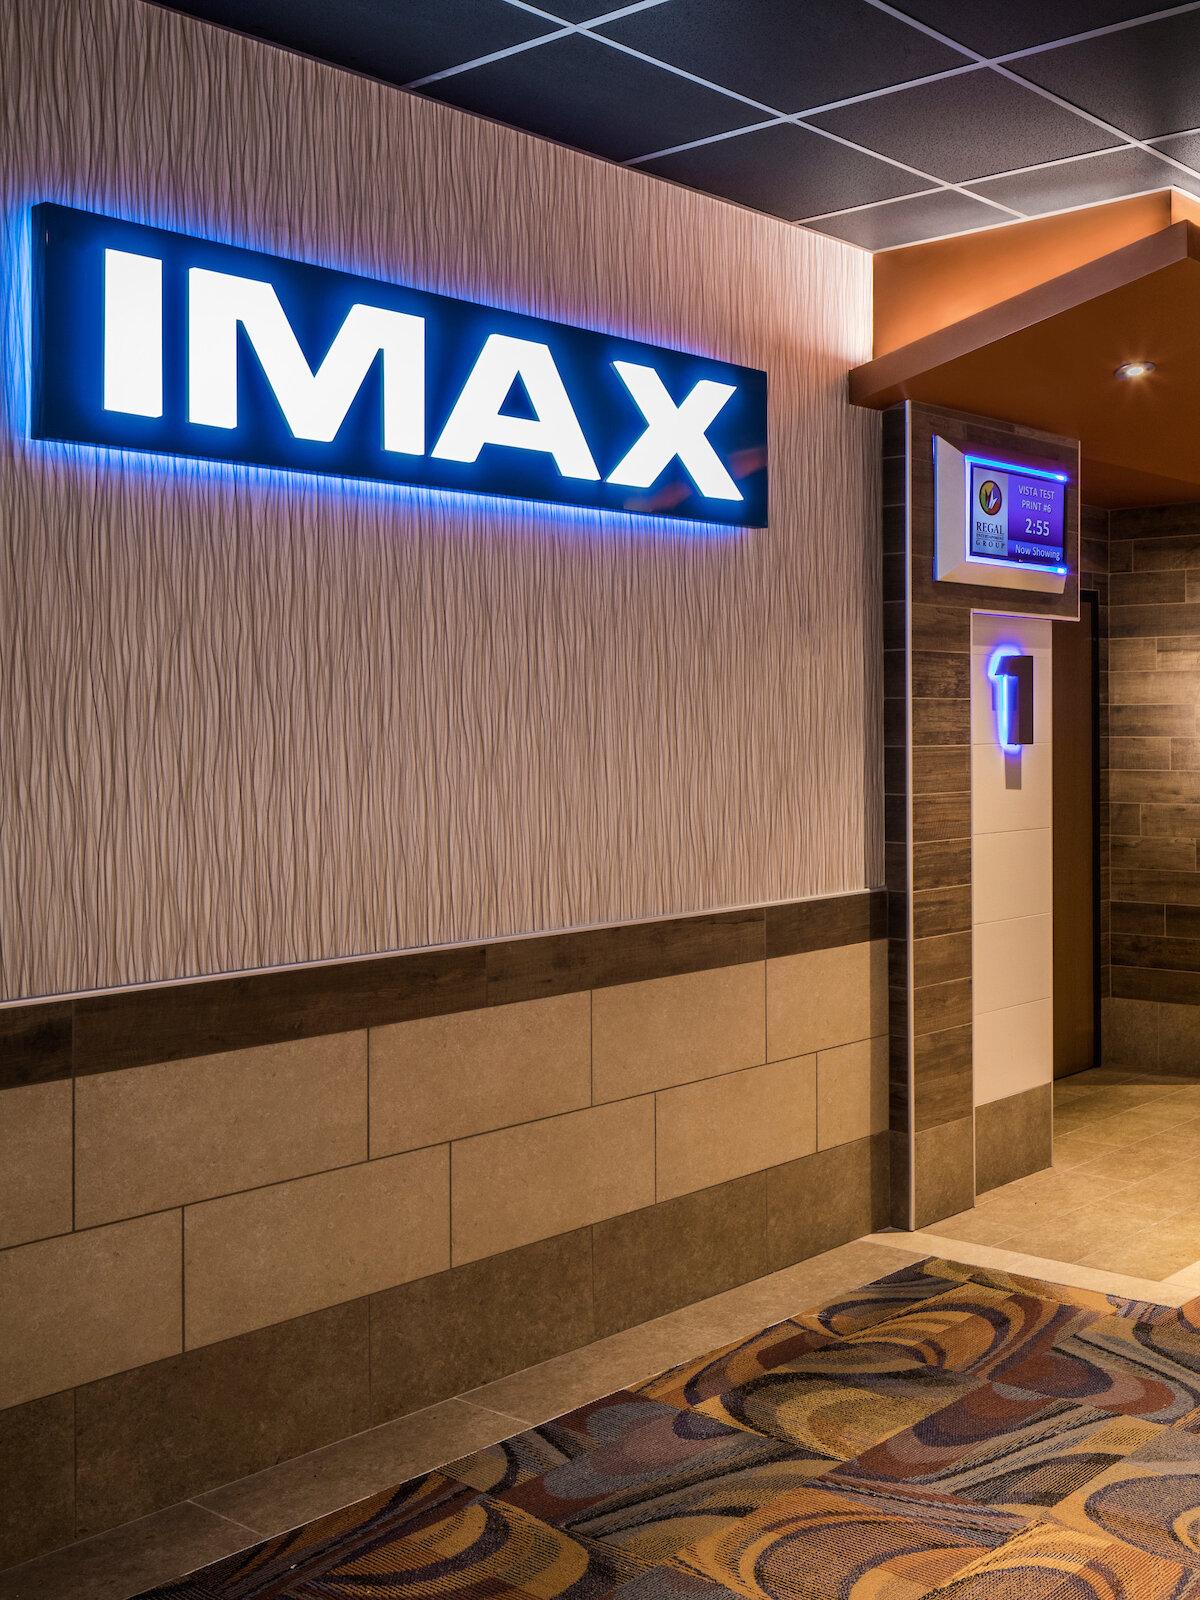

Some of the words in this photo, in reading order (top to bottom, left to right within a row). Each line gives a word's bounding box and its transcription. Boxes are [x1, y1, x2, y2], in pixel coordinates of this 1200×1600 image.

[103, 247, 744, 501] IMAX
[1018, 485, 1038, 497] VISTA
[1039, 489, 1055, 500] TEST
[1021, 499, 1042, 511] PRINT
[976, 521, 1005, 535] REGAL
[1025, 518, 1050, 537] 2:55
[975, 539, 1006, 549] GROUP
[1015, 544, 1032, 555] Now
[1032, 546, 1060, 561] Showing
[994, 655, 1034, 745] 1
